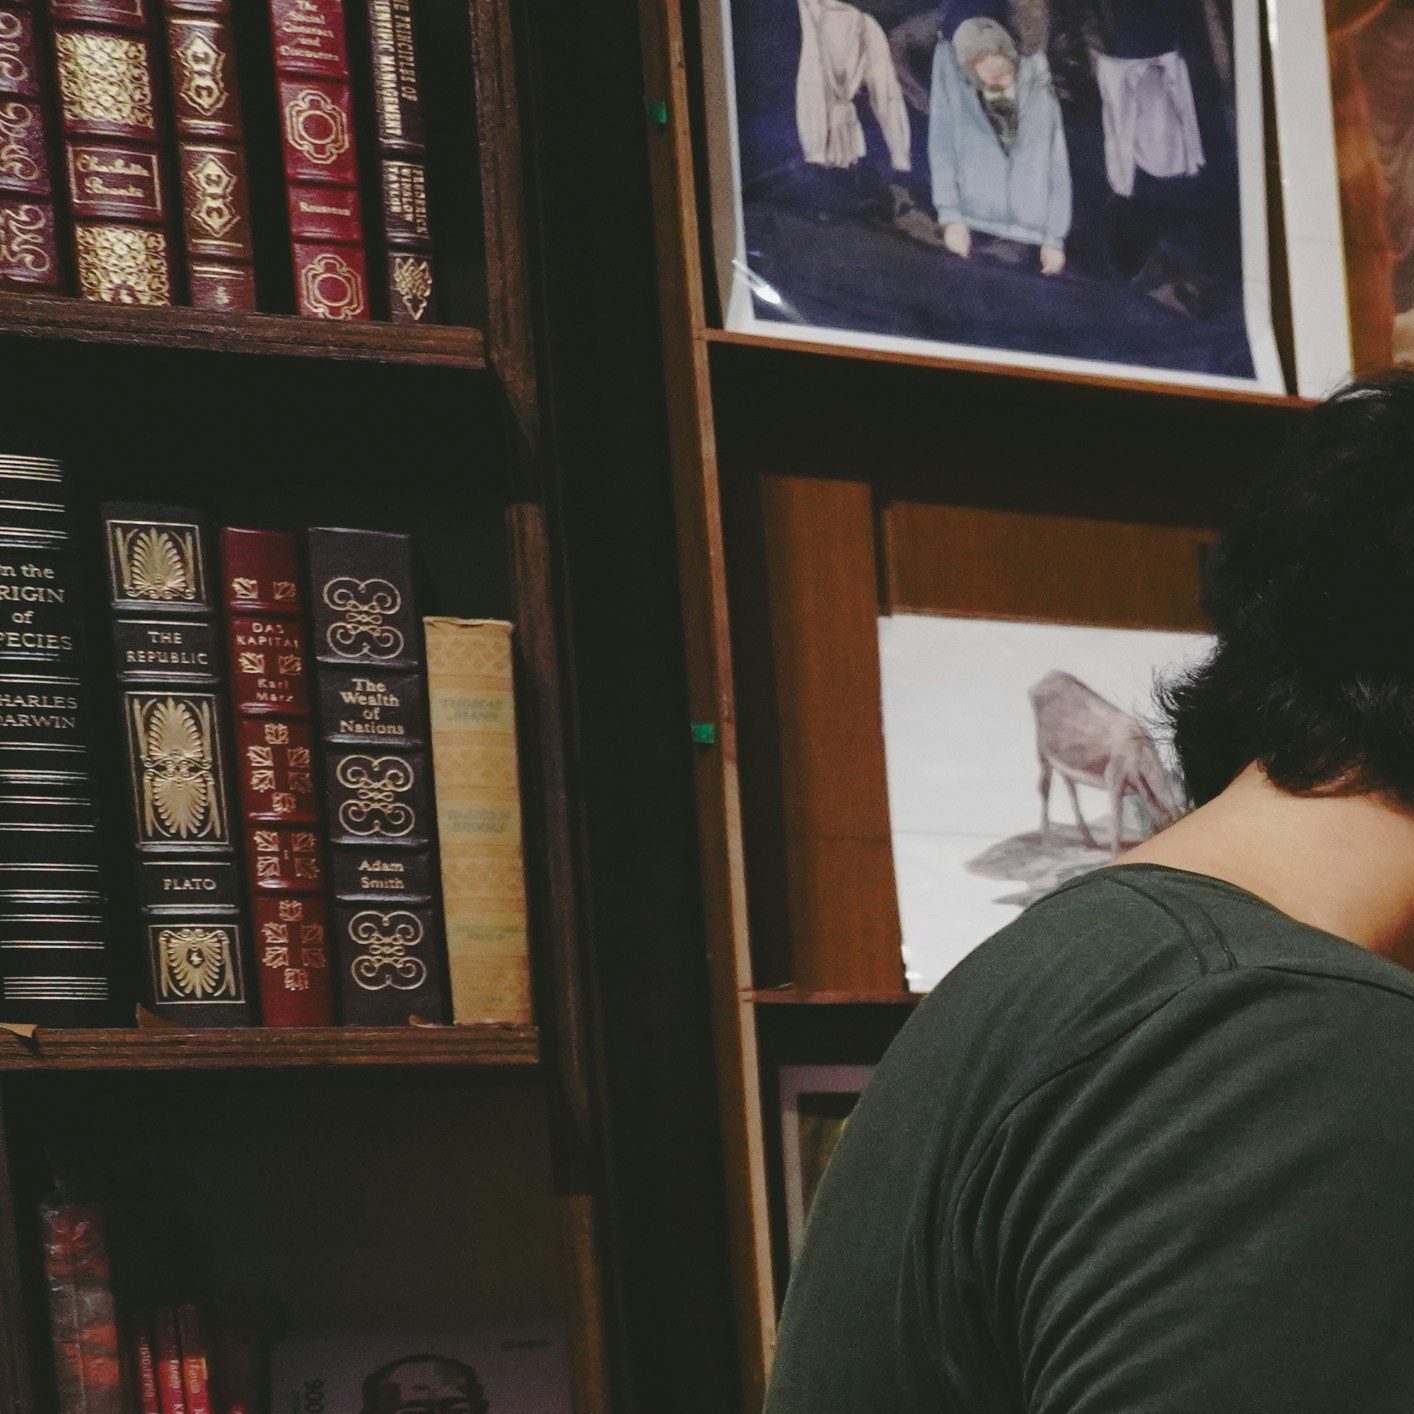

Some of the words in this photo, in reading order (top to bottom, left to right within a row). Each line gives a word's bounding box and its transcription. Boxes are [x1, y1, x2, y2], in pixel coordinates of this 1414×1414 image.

[21, 563, 55, 579] the
[0, 584, 65, 603] RIGIN
[11, 610, 35, 624] of
[0, 631, 73, 650] PECIES
[147, 630, 184, 645] THE
[126, 650, 209, 665] REPUBLIC
[257, 677, 290, 690] Karl
[351, 676, 387, 693] The
[339, 690, 401, 708] Wealth
[362, 707, 382, 720] of
[0, 714, 76, 729] ARWIN
[339, 719, 406, 735] Nations
[357, 858, 405, 873] Adam
[162, 877, 217, 891] PLATO
[360, 875, 406, 890] Smith
